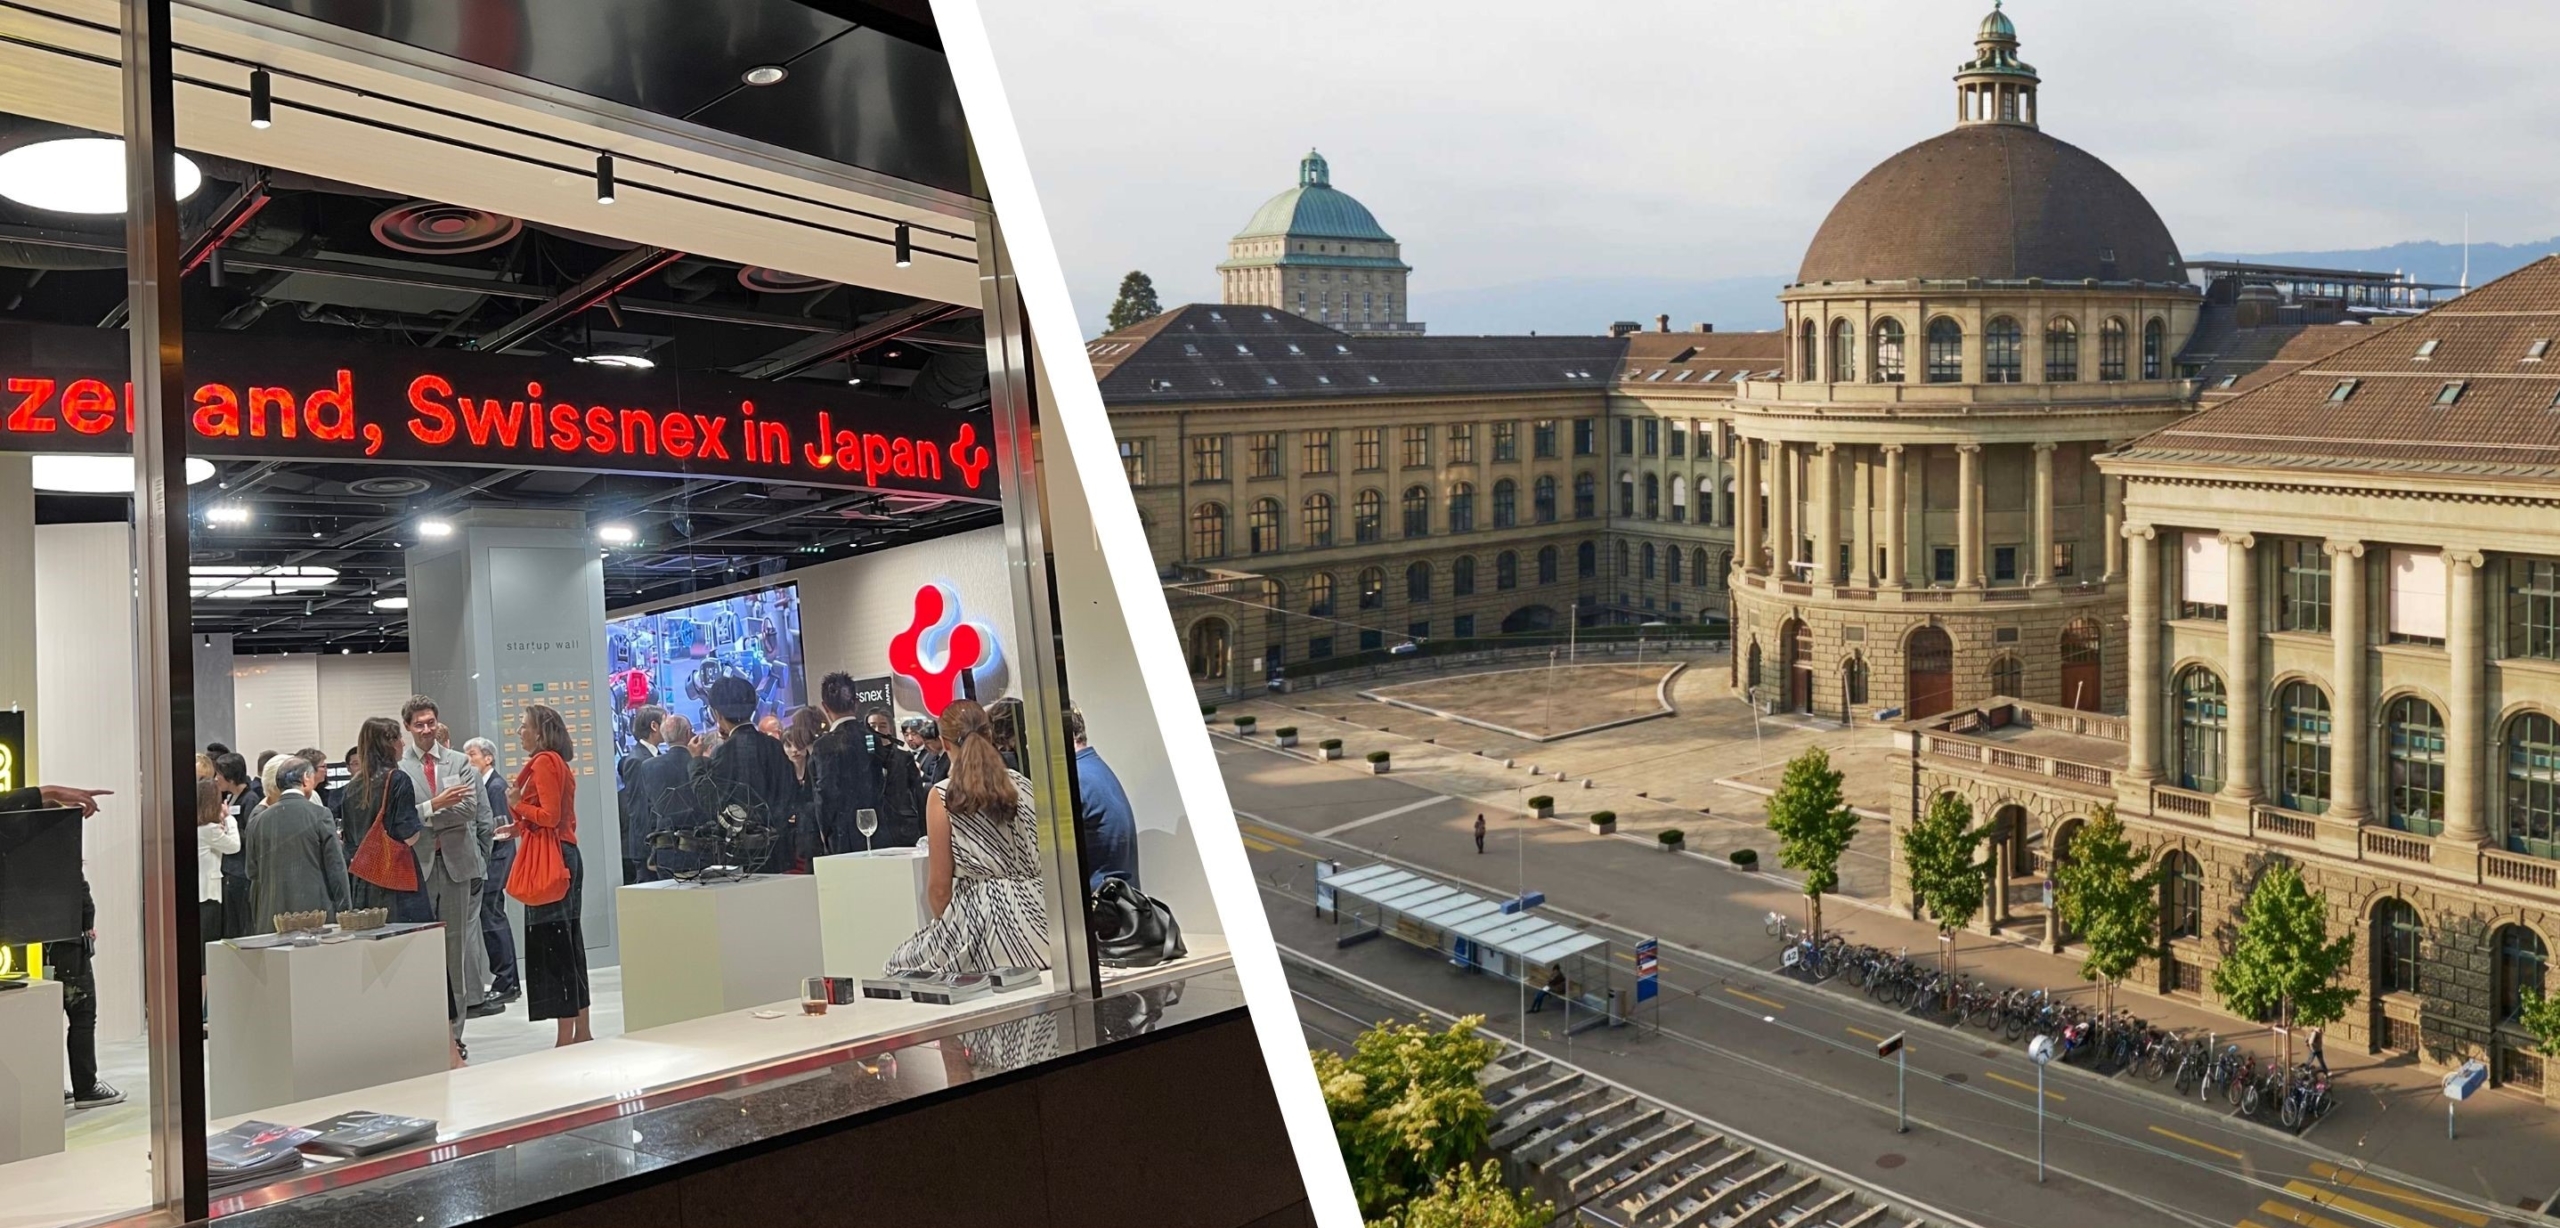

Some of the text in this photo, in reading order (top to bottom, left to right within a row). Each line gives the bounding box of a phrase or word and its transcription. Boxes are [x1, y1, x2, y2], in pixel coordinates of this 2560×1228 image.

[0, 369, 941, 487] zeand, Swissnex in Japan
[507, 640, 579, 651] startup wall
[1785, 951, 1796, 962] 42
